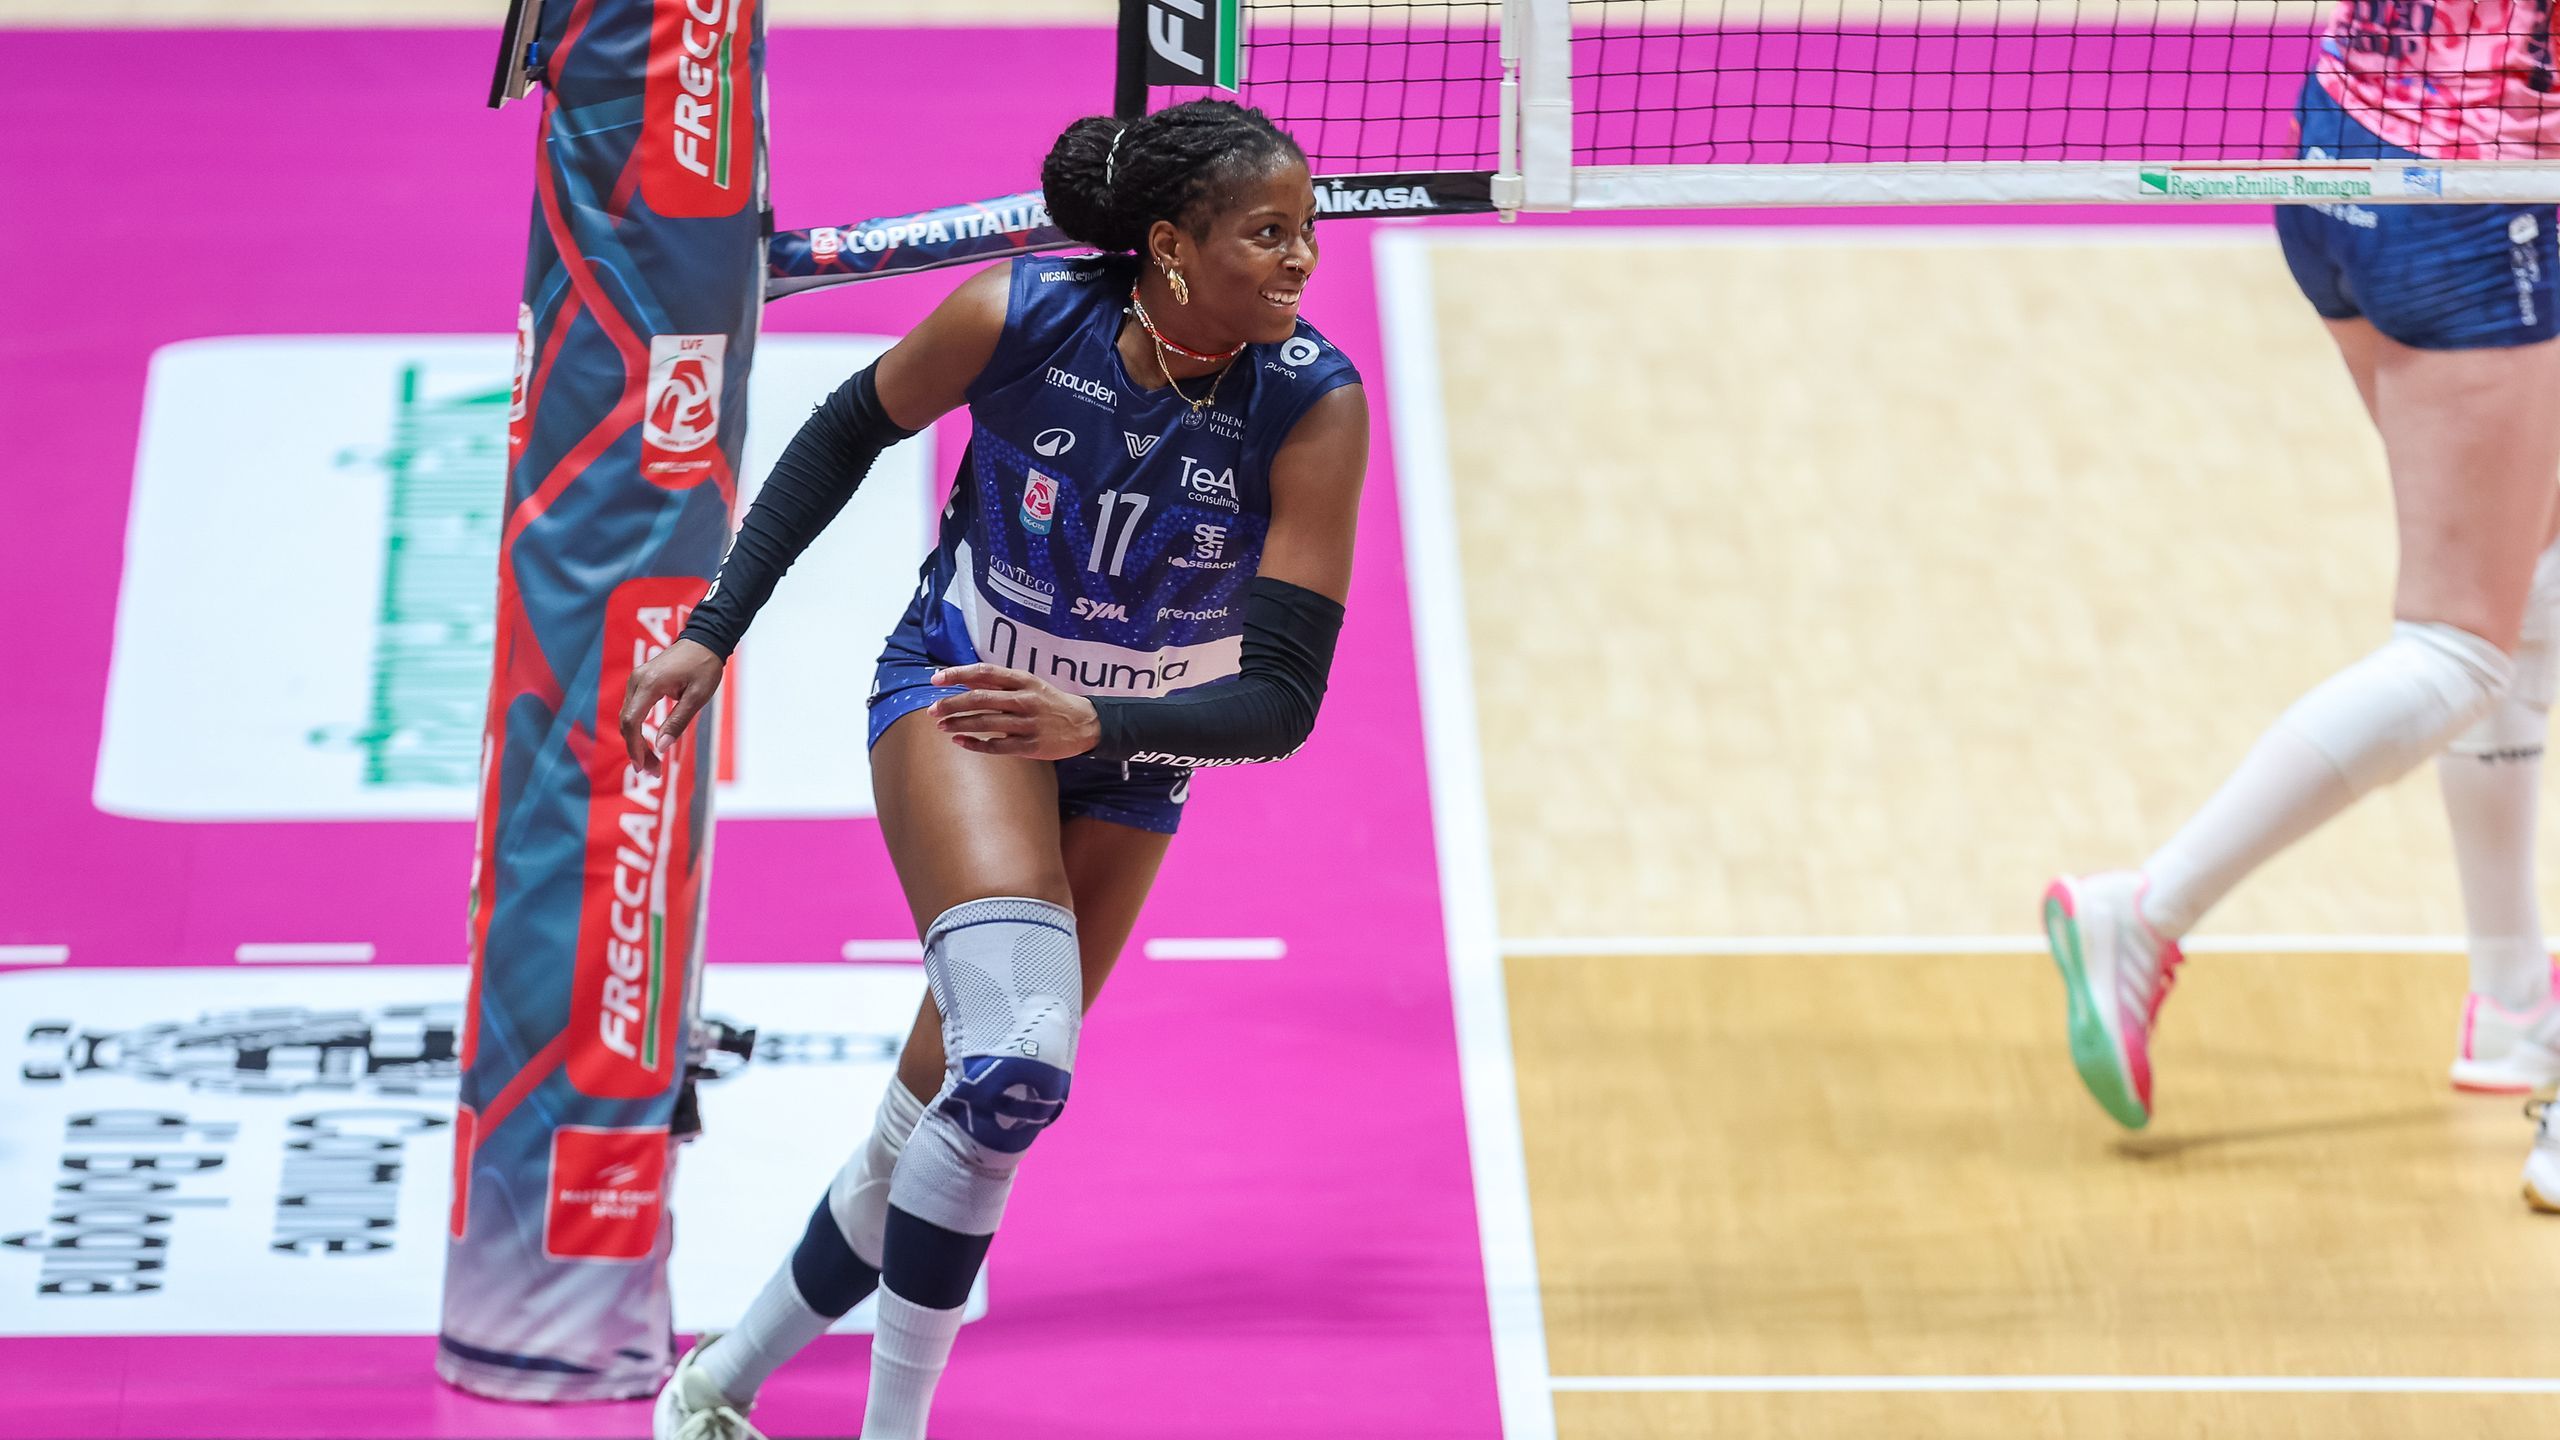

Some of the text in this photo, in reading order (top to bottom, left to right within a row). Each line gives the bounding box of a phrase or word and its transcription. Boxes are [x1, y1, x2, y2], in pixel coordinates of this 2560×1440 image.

[2170, 174, 2233, 199] Regione
[849, 204, 1053, 255] COPPA ITALIA
[680, 339, 703, 350] LVF
[1045, 366, 1118, 407] mauden
[1188, 491, 1240, 514] consulting
[1087, 489, 1151, 577] 17
[990, 554, 1055, 595] CONTECO
[1188, 560, 1236, 569] SEBACH
[1070, 597, 1130, 623] SYM
[1156, 606, 1229, 622] prenatal
[1051, 654, 1190, 690] numia
[269, 1108, 450, 1258] Comune
[0, 1151, 230, 1299] Bologna
